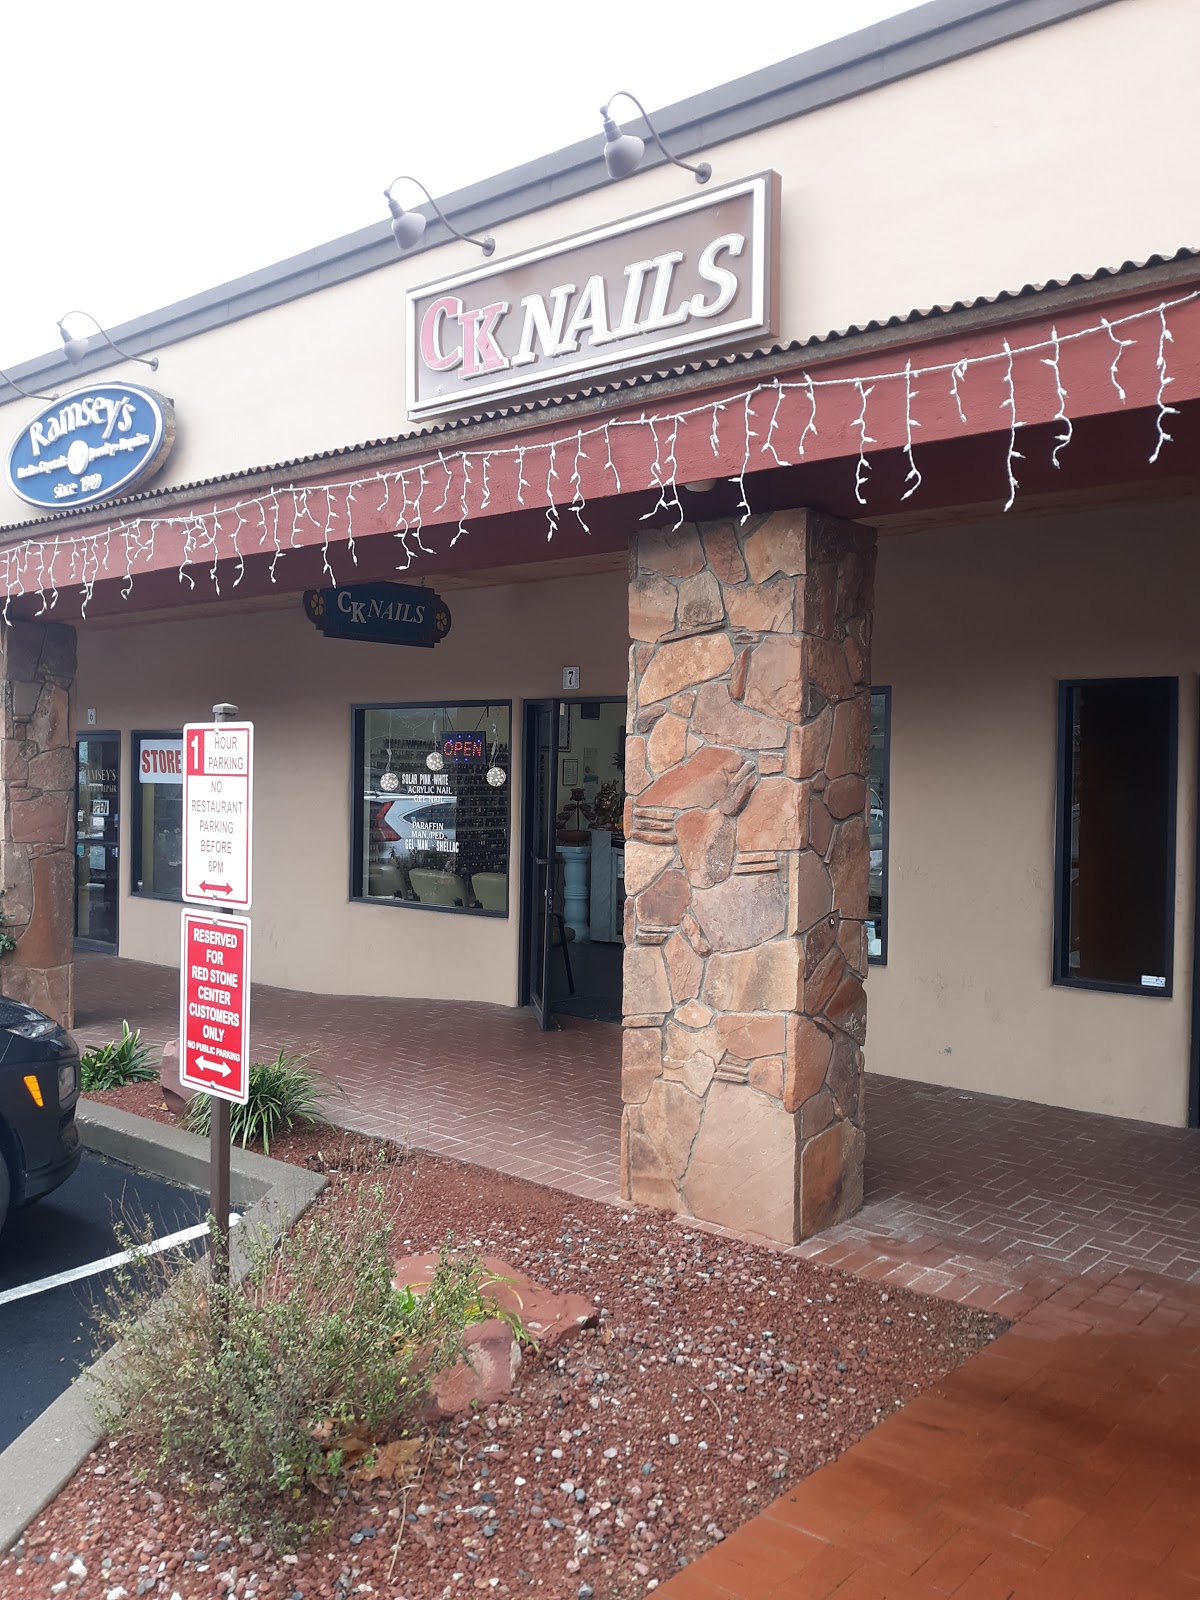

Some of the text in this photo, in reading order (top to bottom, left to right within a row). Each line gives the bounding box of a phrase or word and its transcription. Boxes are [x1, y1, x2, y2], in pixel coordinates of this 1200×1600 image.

[420, 233, 745, 380] CK NAILS
[29, 396, 136, 456] Ramsey's
[337, 591, 426, 624] CK NAILS
[567, 670, 574, 685] 7
[214, 736, 238, 750] HOUR
[443, 741, 483, 757] OPEN
[191, 735, 199, 770] 1
[141, 749, 182, 774] STORE
[208, 757, 244, 770] PARKING
[210, 780, 223, 793] NO
[402, 774, 418, 785] SOLAR
[420, 774, 431, 785] PINK
[408, 786, 453, 795] ACRYLIC NAIL
[414, 795, 427, 803] GEL
[191, 800, 243, 814] RESTAURANT
[199, 820, 234, 834] PARKING
[412, 822, 444, 831] PARAFFIN
[200, 839, 232, 854] BEFORE
[405, 839, 415, 850] GEL
[436, 840, 460, 853] SHELLAC
[208, 860, 224, 873] 6PM
[193, 928, 237, 948] RESERVED
[206, 949, 224, 965] FOR
[191, 965, 238, 988] RED STONE
[197, 985, 231, 1006] CENTER
[189, 1002, 240, 1027] CUSTOMERS
[202, 1024, 225, 1043] ONLY
[187, 1039, 241, 1062] NO PUBLIC PARKING
